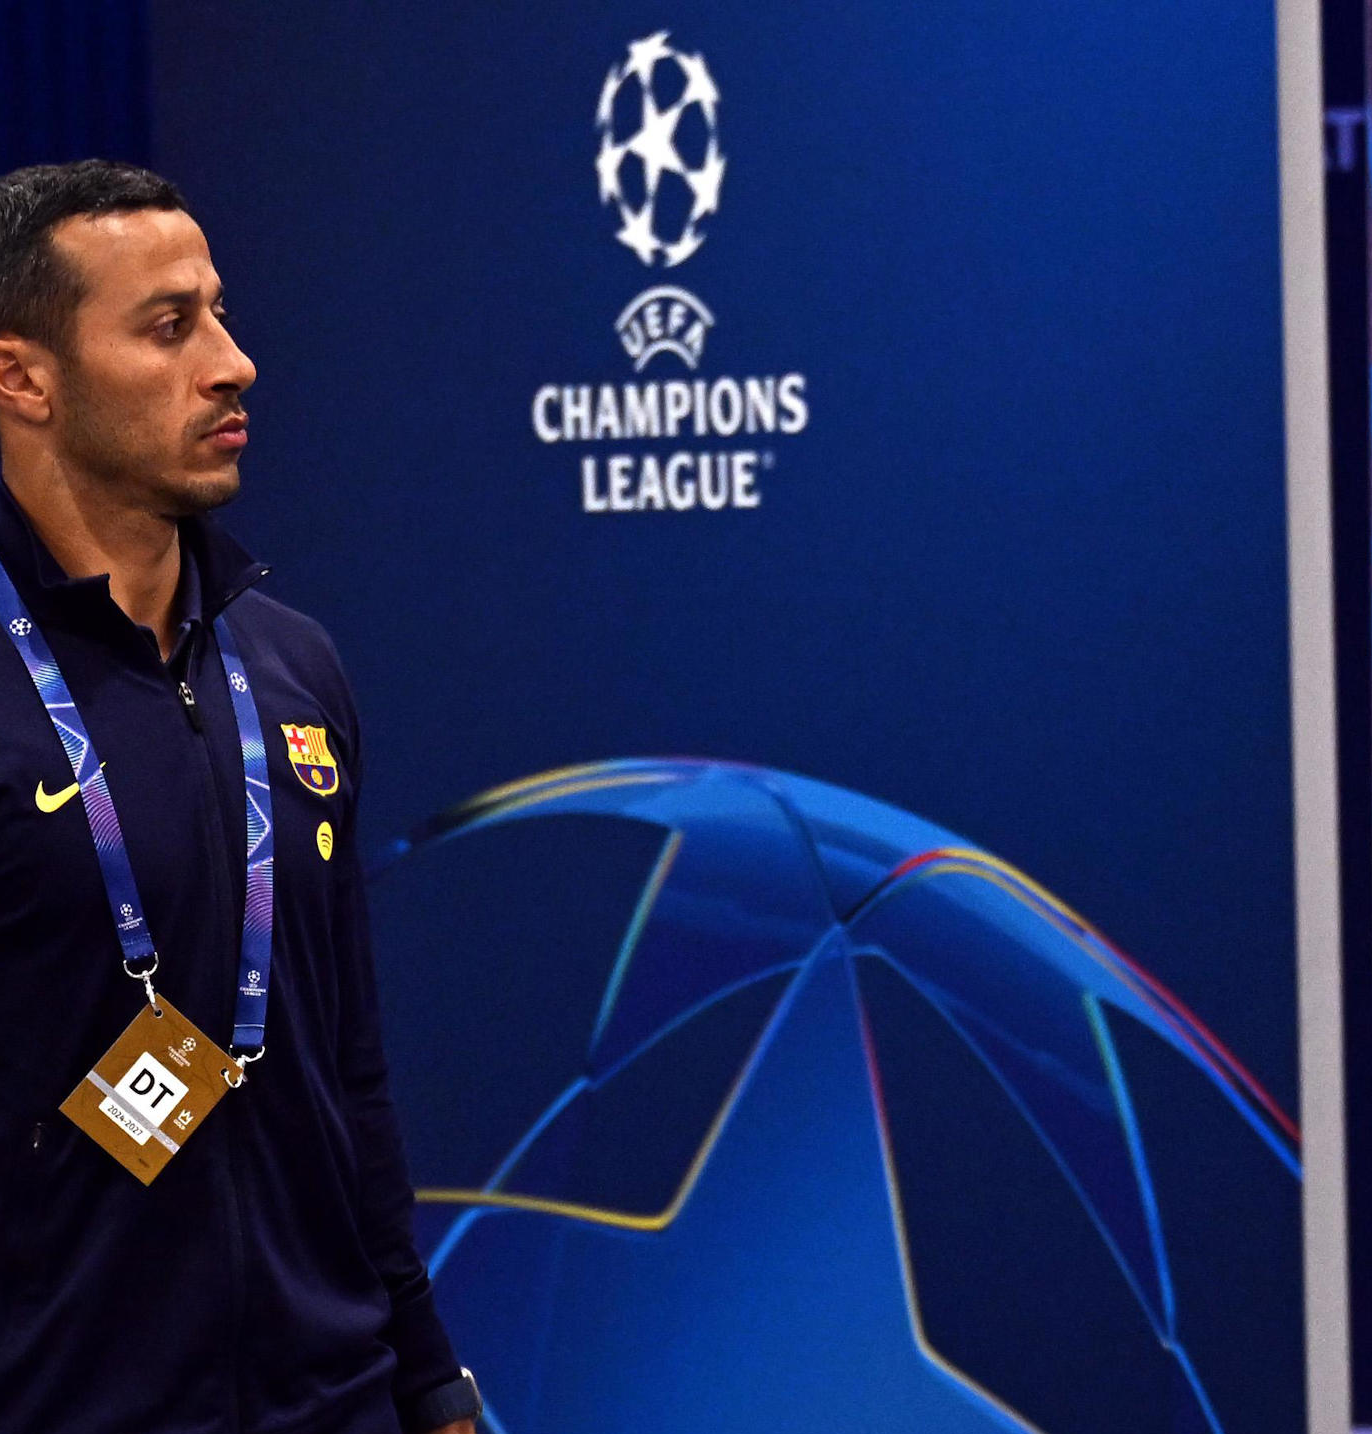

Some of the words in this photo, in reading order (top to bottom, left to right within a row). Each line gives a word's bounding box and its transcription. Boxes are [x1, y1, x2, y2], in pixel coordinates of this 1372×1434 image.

[619, 301, 706, 358] UEFA
[532, 372, 809, 443] CHAMPIONS
[582, 451, 761, 513] LEAGUE
[129, 1067, 175, 1109] DT
[107, 1104, 144, 1136] 2024-2027
